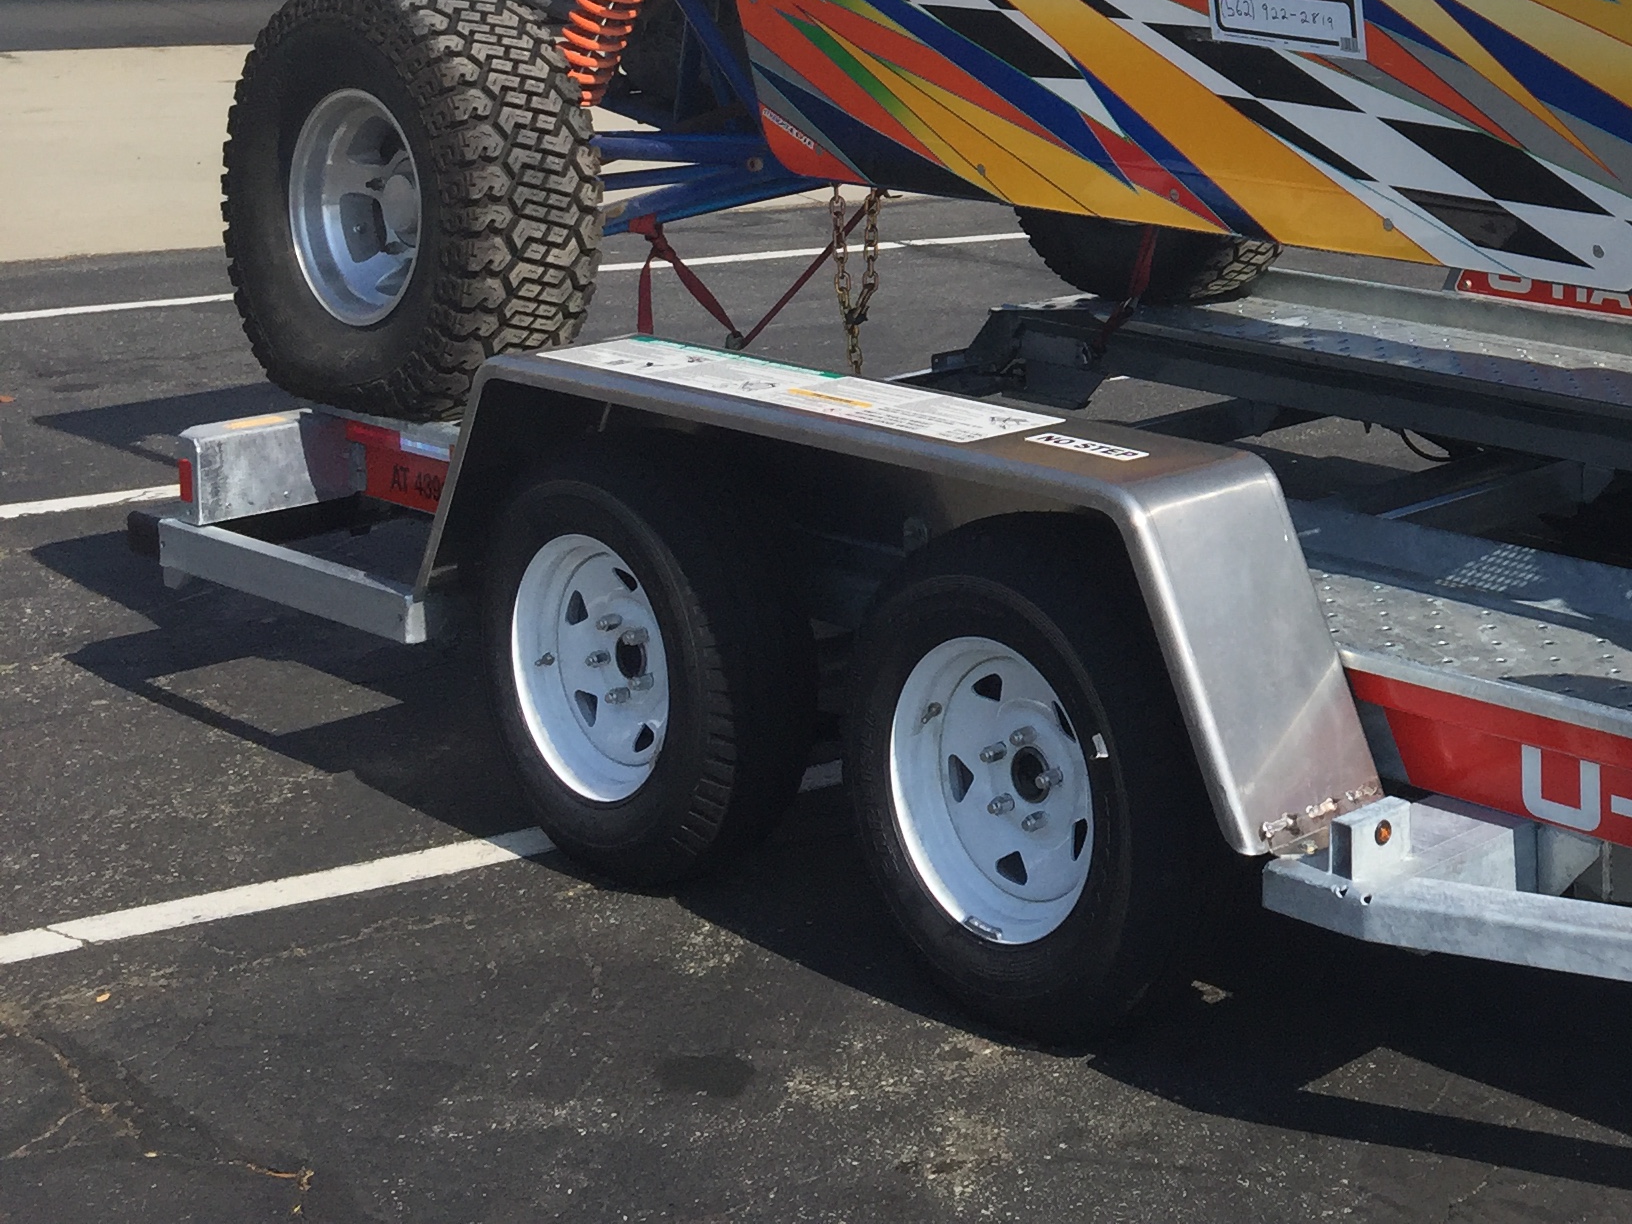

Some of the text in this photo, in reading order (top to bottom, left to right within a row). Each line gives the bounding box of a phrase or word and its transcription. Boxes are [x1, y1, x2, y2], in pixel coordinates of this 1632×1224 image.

[1037, 435, 1139, 457] NO STEP
[389, 463, 444, 502] AT 439
